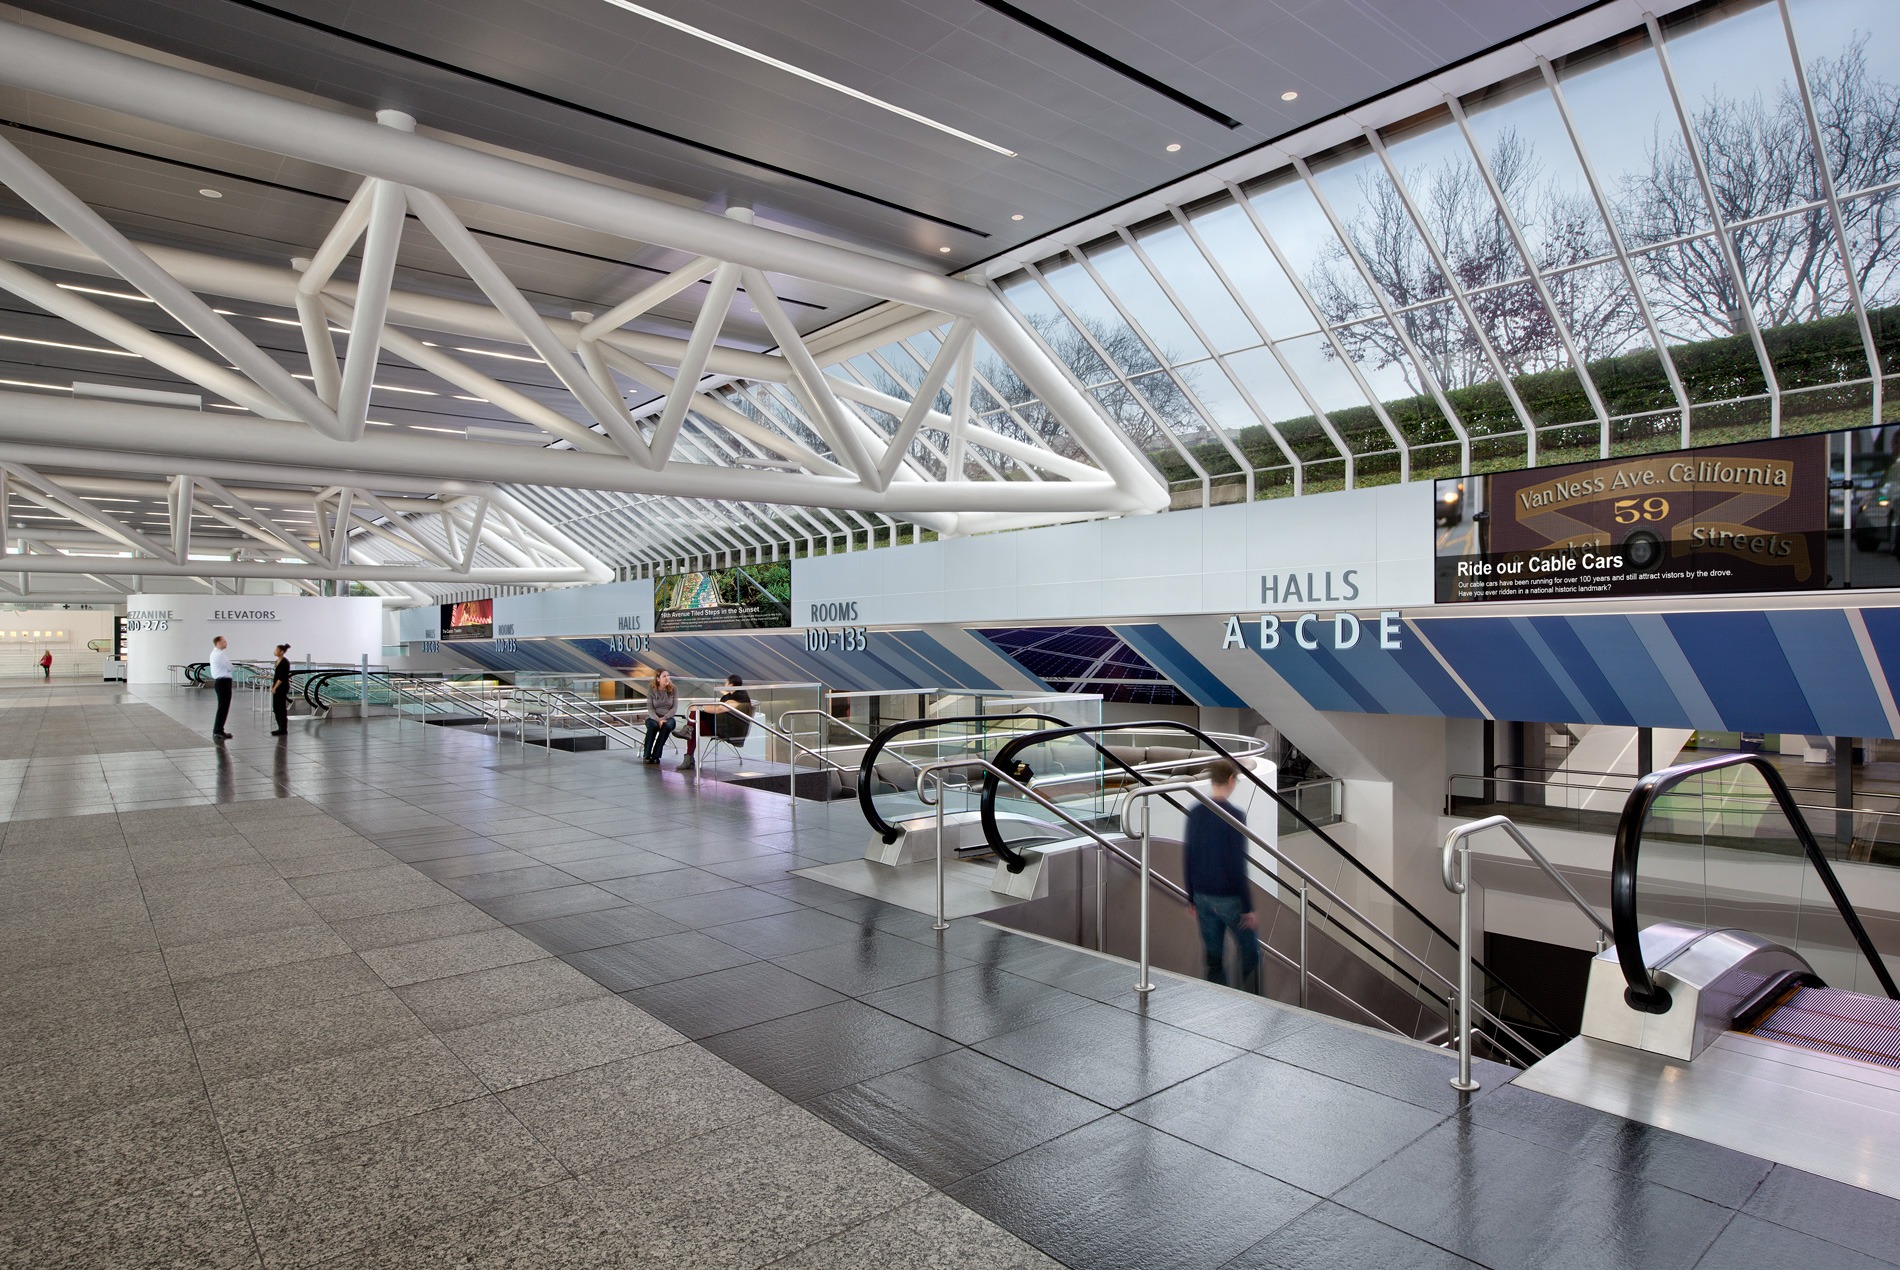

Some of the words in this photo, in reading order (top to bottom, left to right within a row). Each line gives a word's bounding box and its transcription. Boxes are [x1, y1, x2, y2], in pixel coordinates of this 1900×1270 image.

[1520, 487, 1554, 511] Van
[1554, 476, 1605, 502] Ness
[1668, 461, 1789, 488] California
[1614, 497, 1670, 524] 59
[1690, 527, 1793, 556] Streets
[1457, 561, 1492, 577] Ride
[1496, 561, 1524, 575] our
[1528, 555, 1577, 573] Cable
[1581, 553, 1624, 569] Cars
[1261, 570, 1359, 604] HALLS
[1469, 580, 1485, 588] cable
[1530, 578, 1553, 586] running
[1554, 577, 1563, 585] for
[1592, 576, 1611, 584] years
[1638, 572, 1660, 580] attract
[1686, 571, 1695, 579] by
[1709, 569, 1733, 577] drove.
[1530, 586, 1553, 594] national
[1554, 585, 1577, 593] historic
[1578, 584, 1612, 592] landmark?
[214, 611, 276, 619] ELEVATORS
[704, 609, 720, 617] Steps
[738, 606, 760, 614] Sunset
[811, 601, 858, 622] ROOMS
[127, 620, 169, 631] 00-276
[498, 624, 514, 636] ROOMS
[618, 615, 640, 631] HALLS
[803, 627, 867, 651] 100-135
